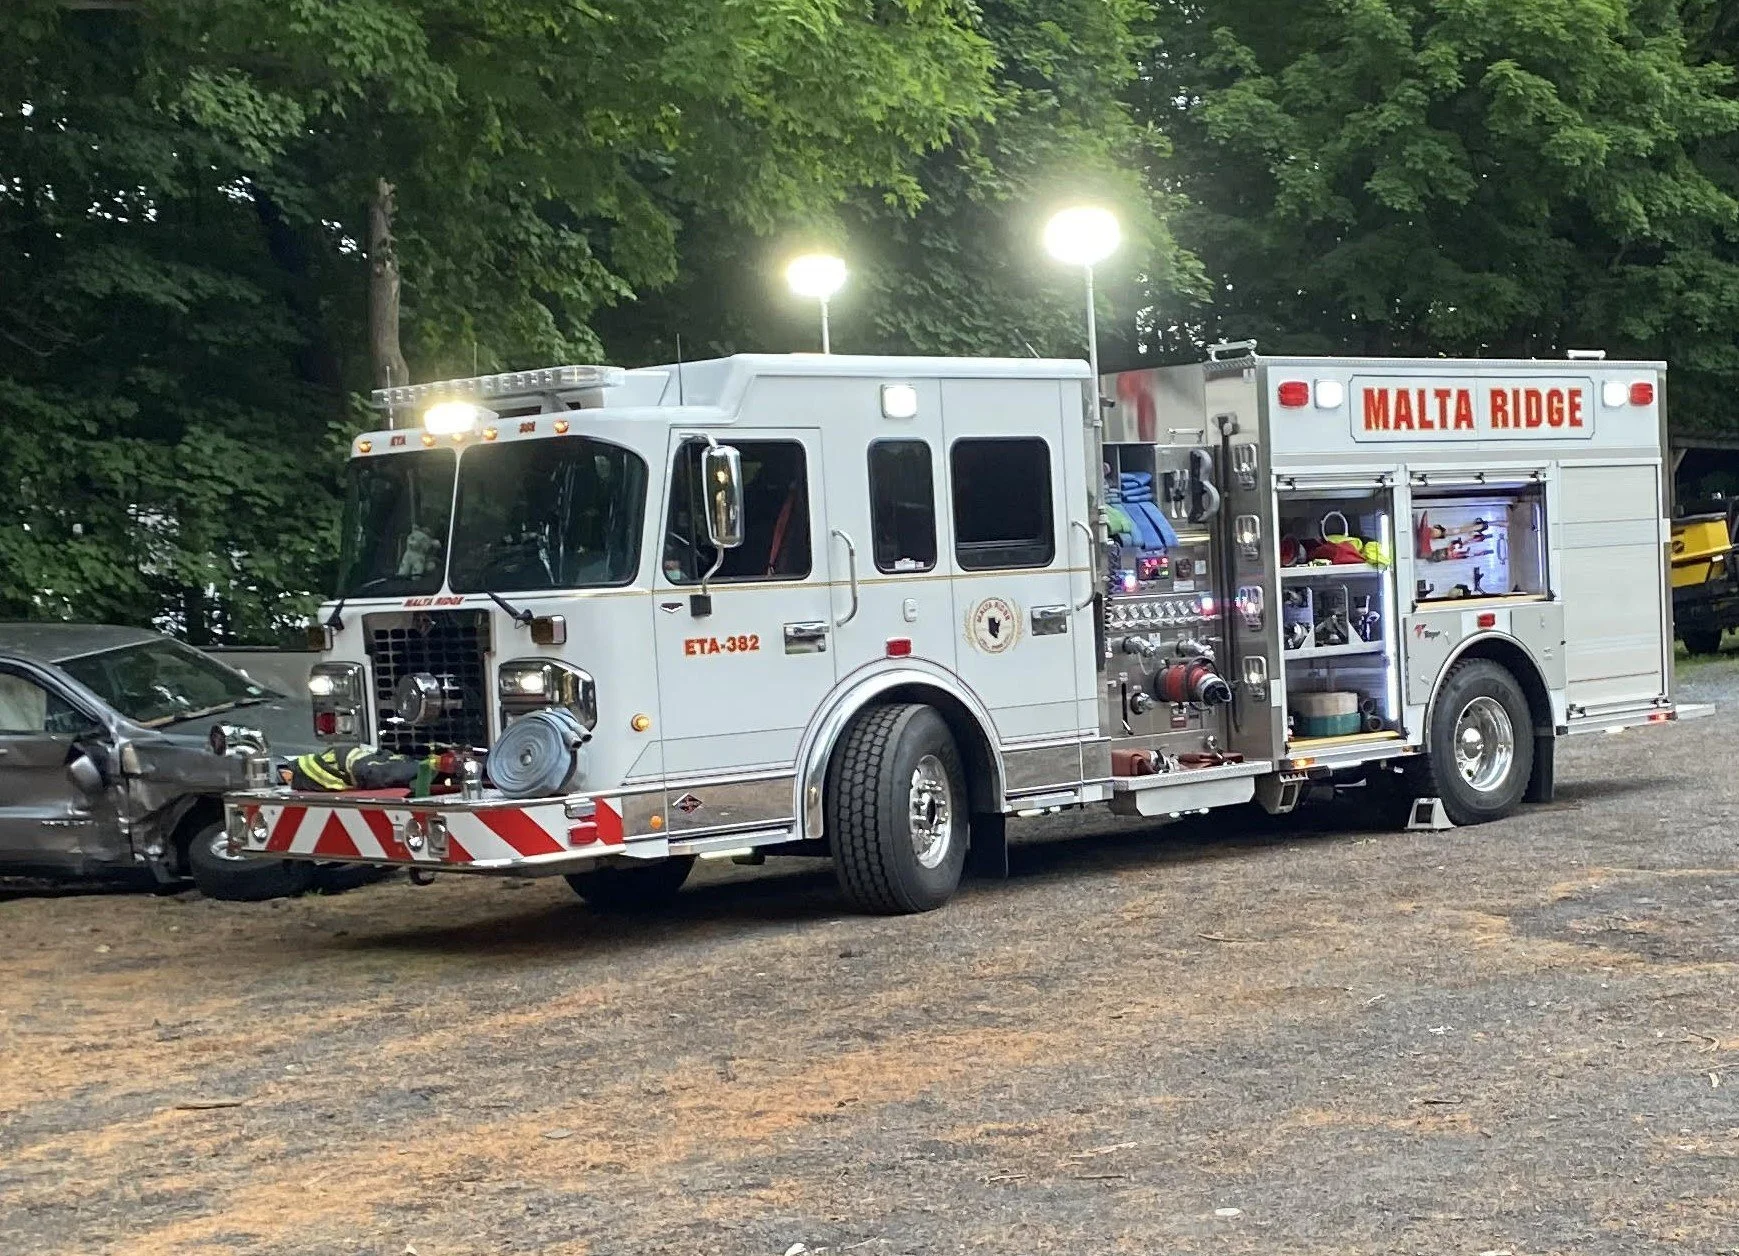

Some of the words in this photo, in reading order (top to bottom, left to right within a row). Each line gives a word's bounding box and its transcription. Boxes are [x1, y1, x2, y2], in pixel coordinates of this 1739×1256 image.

[1363, 388, 1474, 430] MALTA
[1490, 388, 1584, 428] RIDGE
[684, 634, 760, 655] ETA-382
